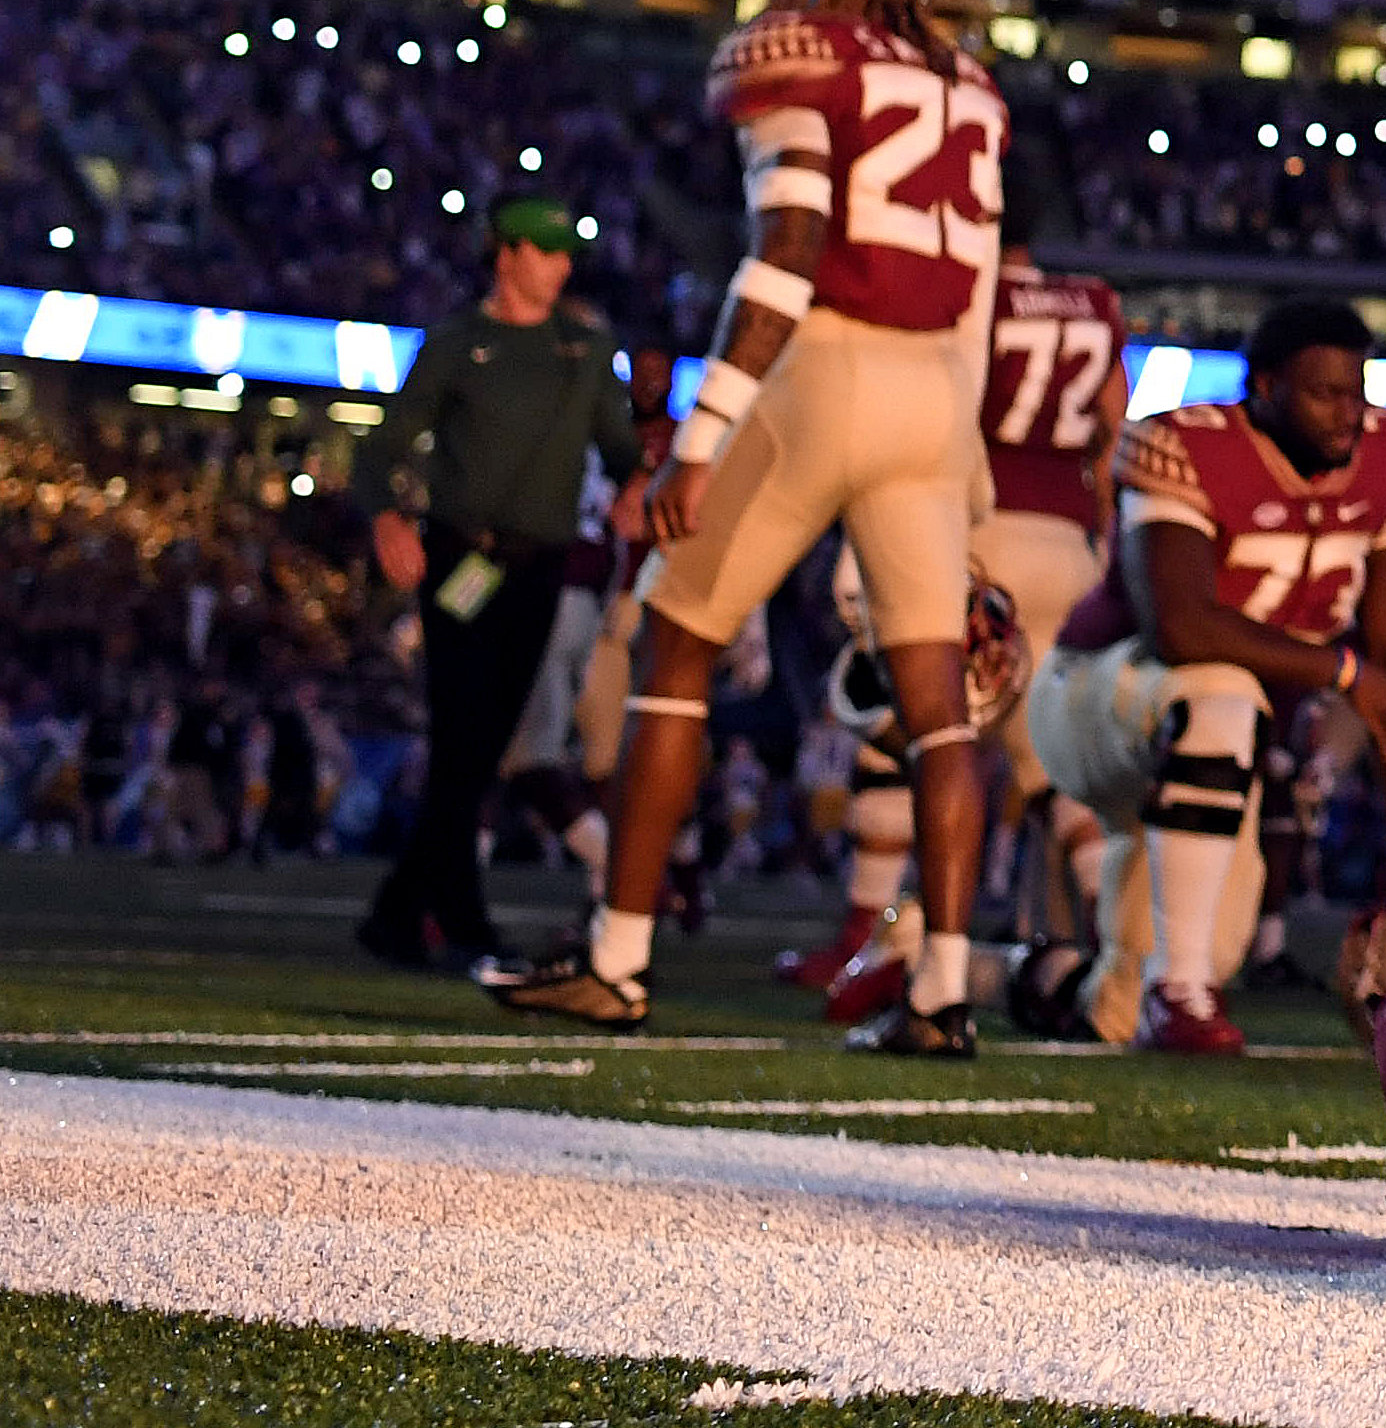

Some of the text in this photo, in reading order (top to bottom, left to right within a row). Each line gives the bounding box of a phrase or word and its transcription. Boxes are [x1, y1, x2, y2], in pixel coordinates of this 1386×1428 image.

[846, 62, 1004, 267] 23
[994, 319, 1113, 447] 72
[1225, 530, 1371, 647] 73
